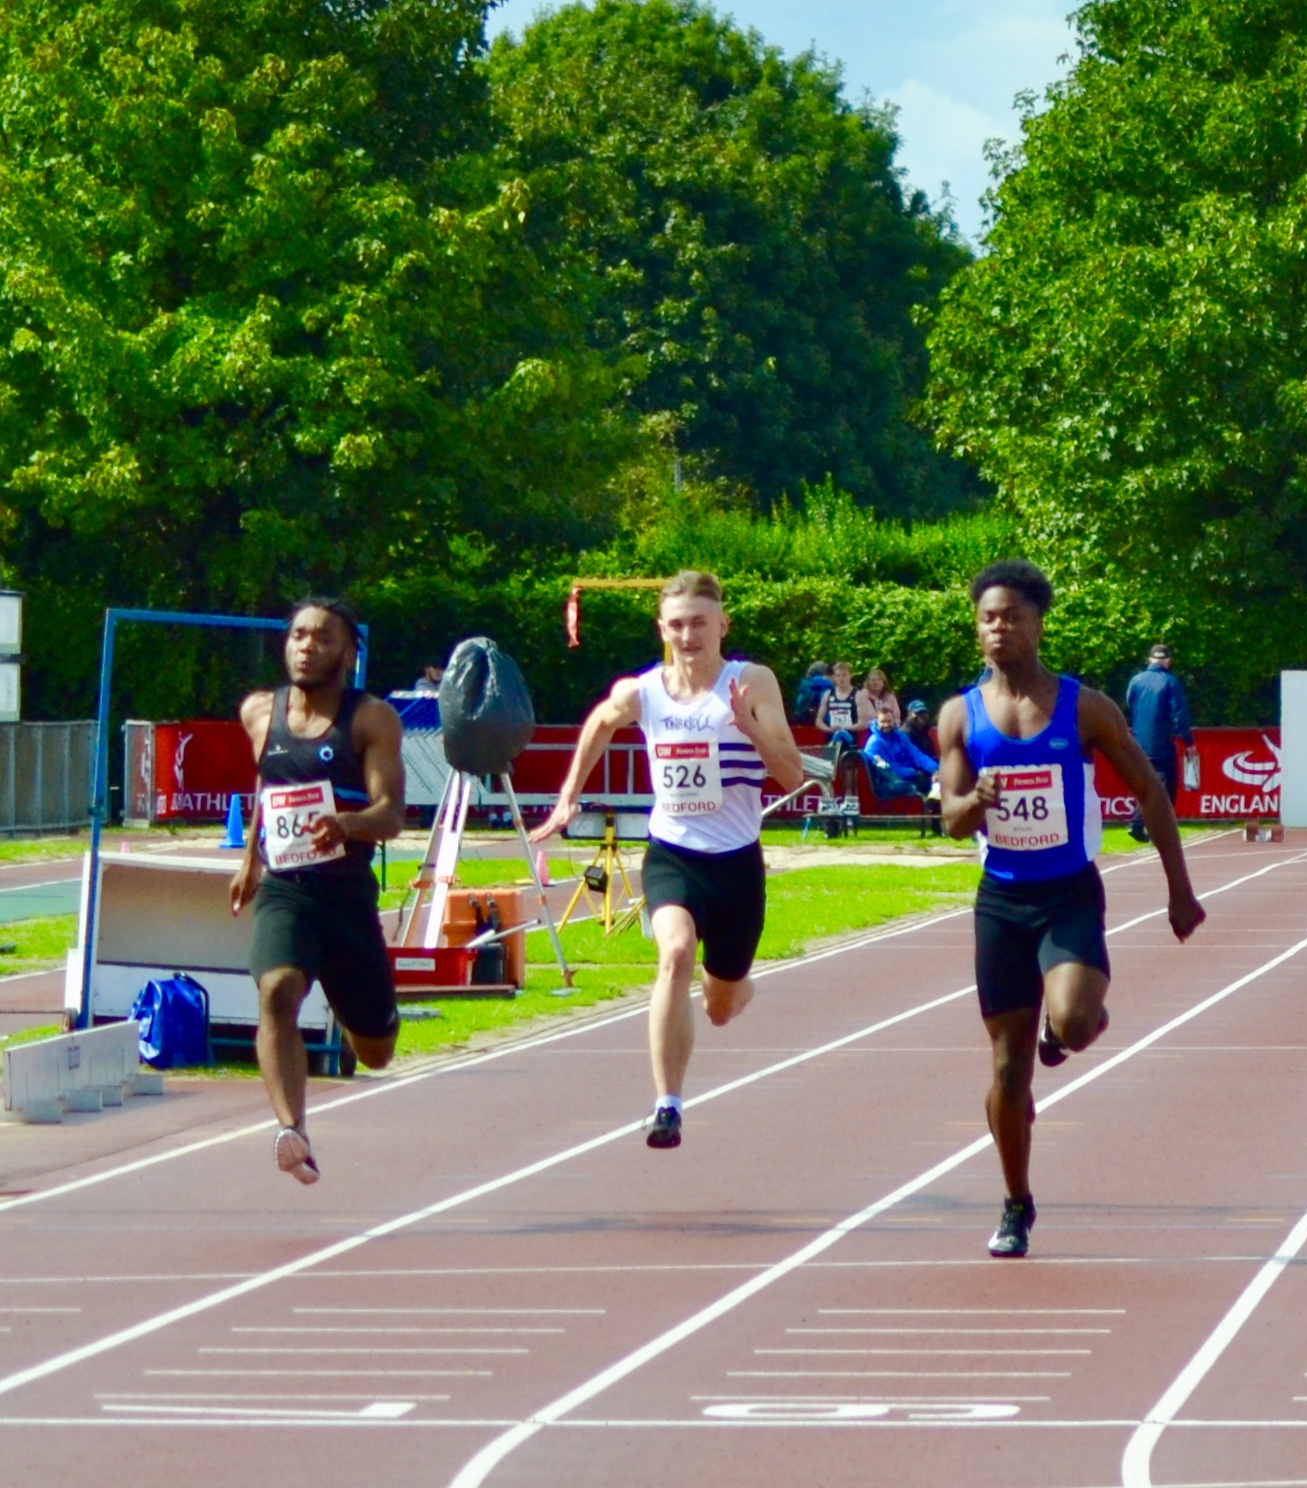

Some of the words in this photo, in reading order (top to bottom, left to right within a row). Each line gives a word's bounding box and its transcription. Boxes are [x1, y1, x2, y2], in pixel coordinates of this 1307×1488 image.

[663, 765, 706, 788] 526
[662, 801, 716, 813] BEDFORD
[996, 796, 1049, 822] 548
[1201, 794, 1280, 813] ENGLAN
[995, 833, 1060, 847] BEDFORD
[275, 849, 337, 865] BEDFO
